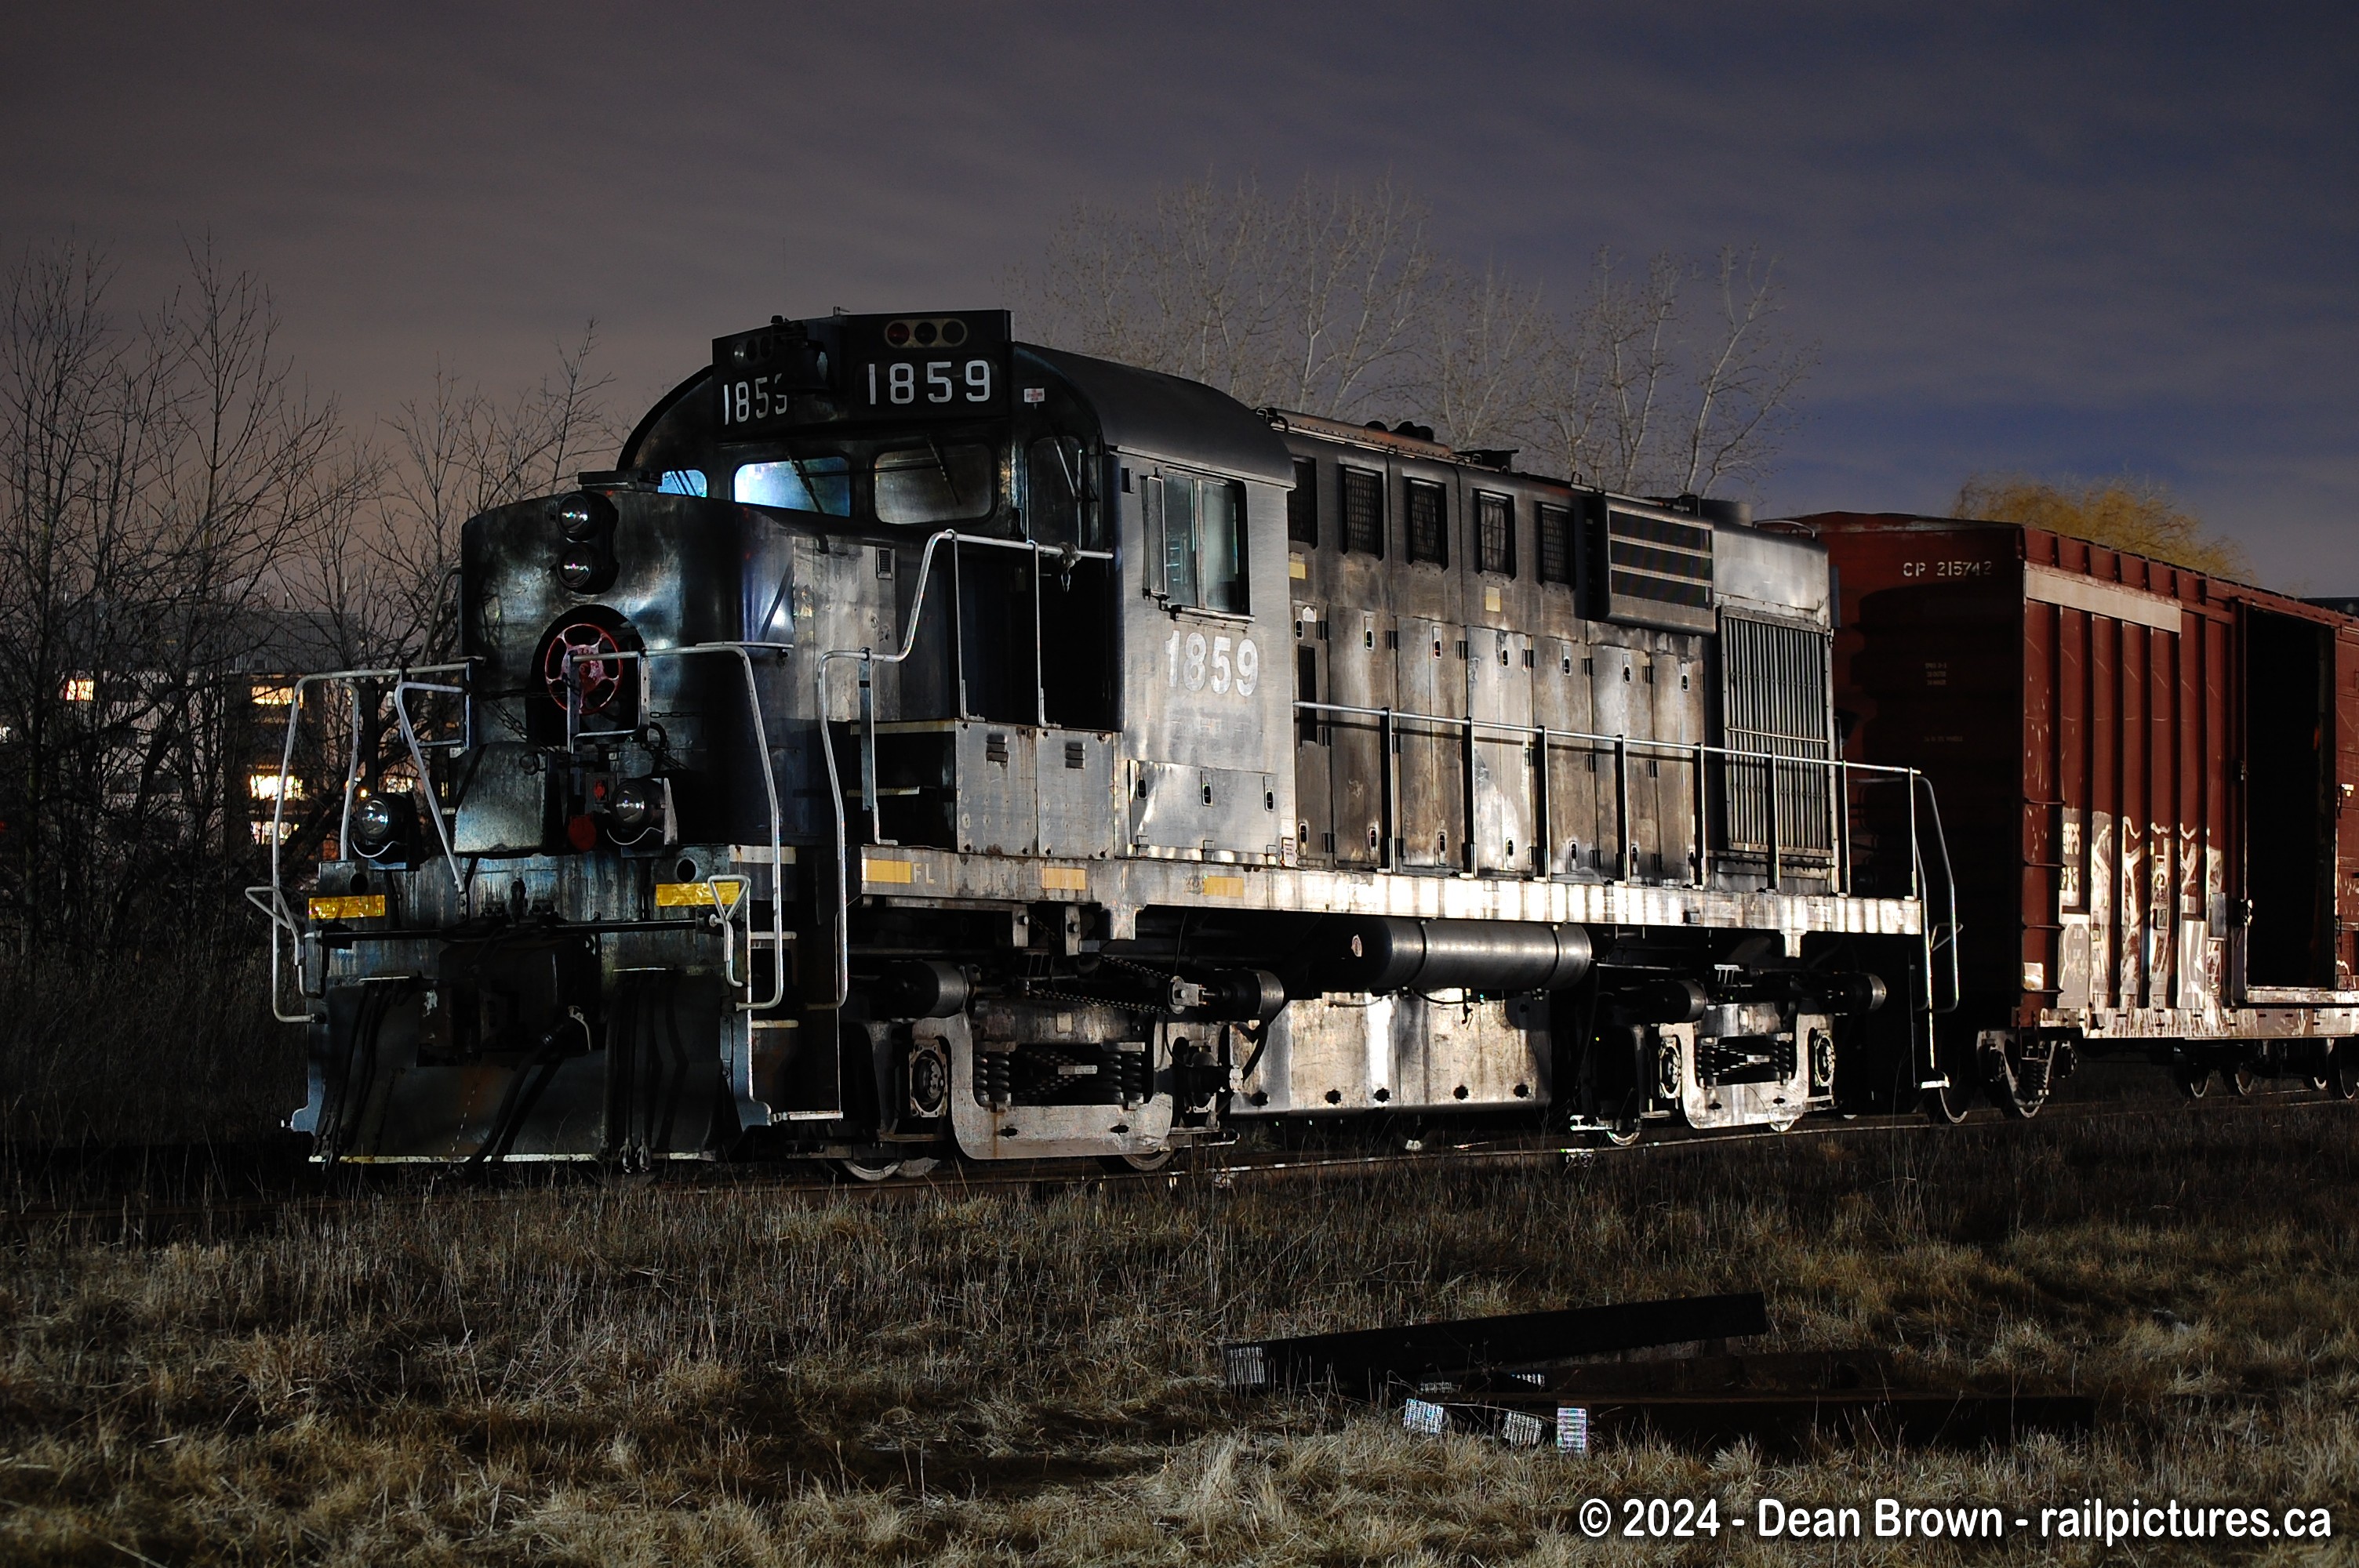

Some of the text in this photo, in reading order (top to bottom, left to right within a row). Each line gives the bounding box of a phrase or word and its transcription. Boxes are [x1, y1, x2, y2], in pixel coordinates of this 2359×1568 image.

[868, 360, 990, 405] 1859
[1903, 561, 1992, 577] CP 215742
[1165, 630, 1259, 697] 1859
[913, 862, 936, 884] FL
